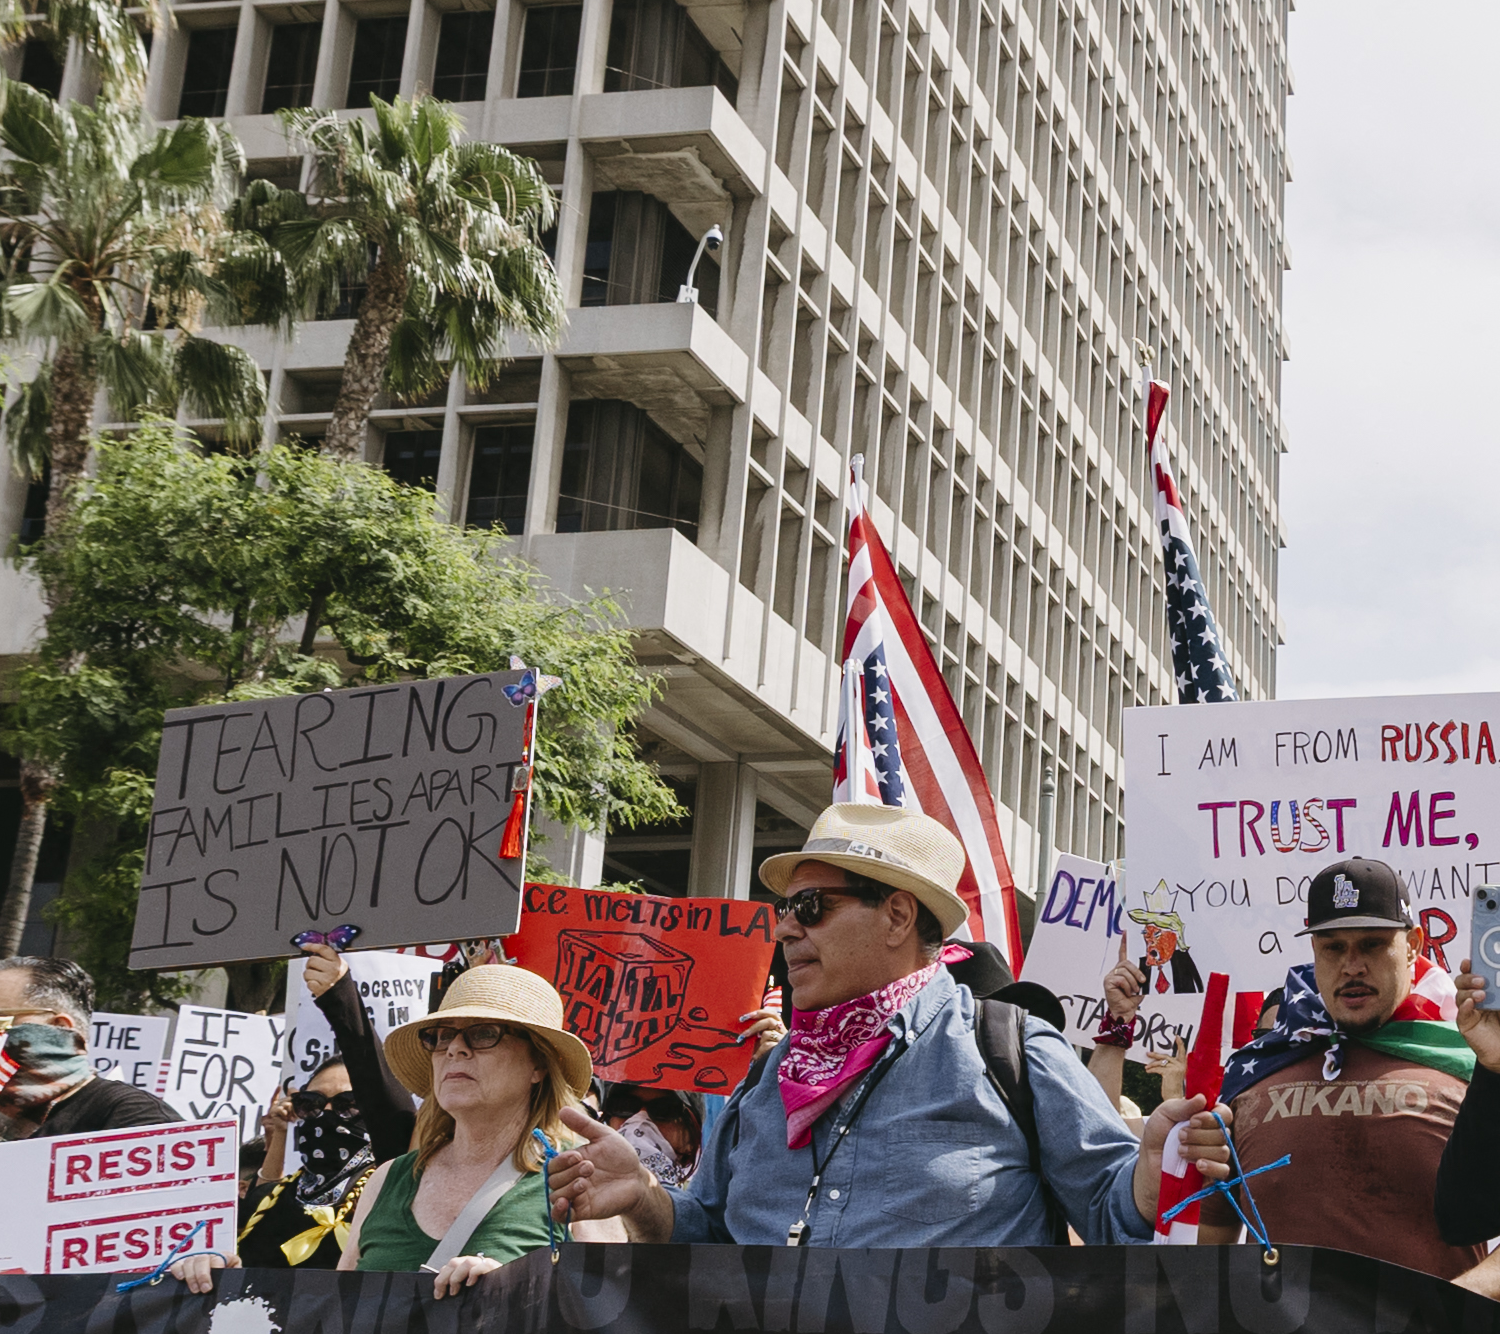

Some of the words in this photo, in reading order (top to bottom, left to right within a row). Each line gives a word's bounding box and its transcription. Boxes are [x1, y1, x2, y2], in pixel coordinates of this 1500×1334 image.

[163, 677, 497, 800] TEARING
[1157, 733, 1172, 776] I
[1198, 736, 1239, 770] AM
[1274, 727, 1358, 767] FROM
[147, 777, 394, 875] FAMILIES
[401, 762, 528, 816] APART
[1198, 797, 1357, 858] TRUST
[1383, 791, 1480, 851] ME,
[130, 868, 239, 952] IS
[275, 820, 410, 931] NOT
[414, 811, 520, 905] OK
[1176, 878, 1251, 914] YOU
[92, 1021, 142, 1051] THE
[184, 1010, 248, 1049] IF
[177, 1051, 258, 1104] FOR
[1262, 1083, 1429, 1124] XIKANO
[65, 1136, 225, 1185] RESIST
[61, 1216, 224, 1274] RESIST
